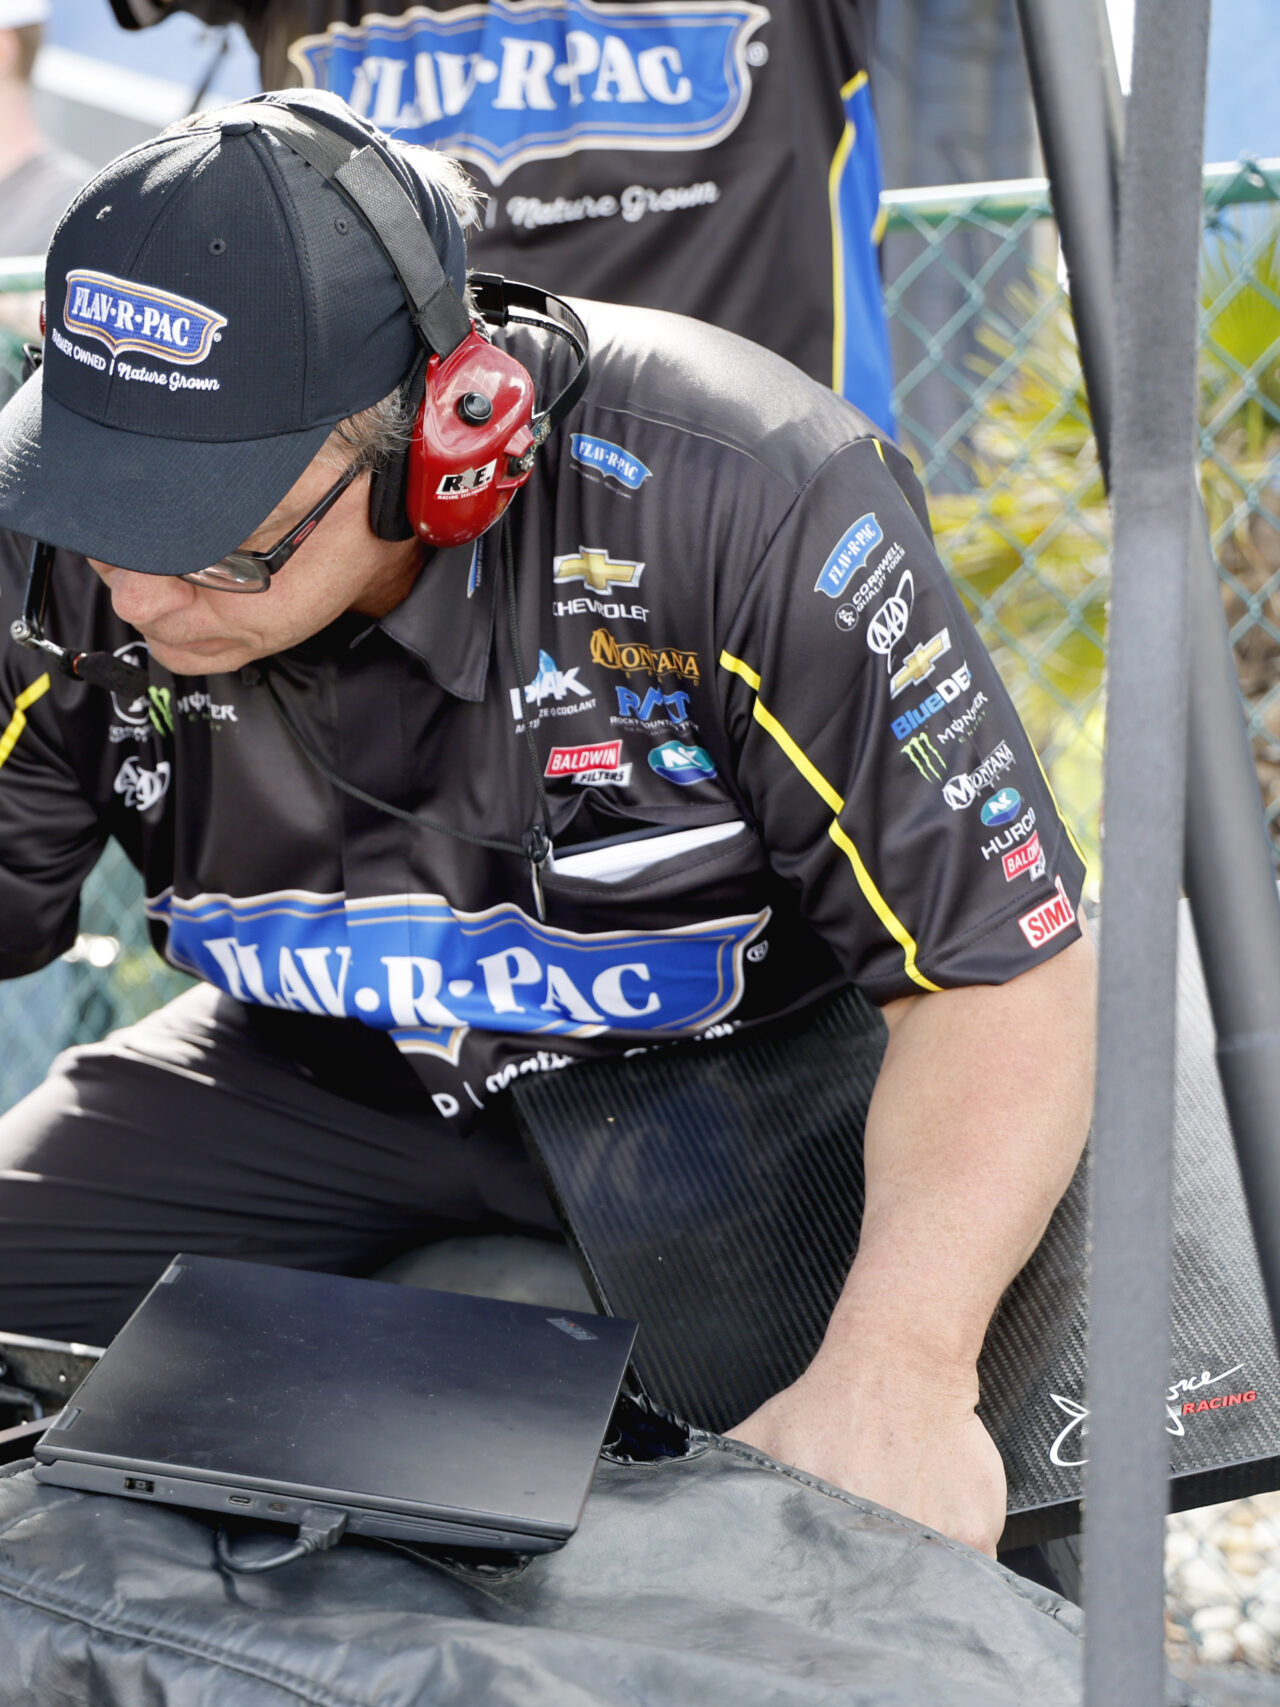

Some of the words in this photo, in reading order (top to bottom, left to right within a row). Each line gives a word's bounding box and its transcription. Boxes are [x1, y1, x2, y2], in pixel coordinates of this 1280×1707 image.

[621, 181, 720, 223] Grown
[73, 345, 107, 371] OWNED
[117, 361, 168, 386] Nature
[169, 371, 220, 392] Grown
[852, 541, 902, 606] CORNWELL
[886, 547, 906, 574] TOOLS
[551, 752, 618, 771] BALDWIN
[579, 769, 625, 783] FILTERS
[980, 807, 1037, 861] HURCO
[1182, 1390, 1258, 1416] RACING
